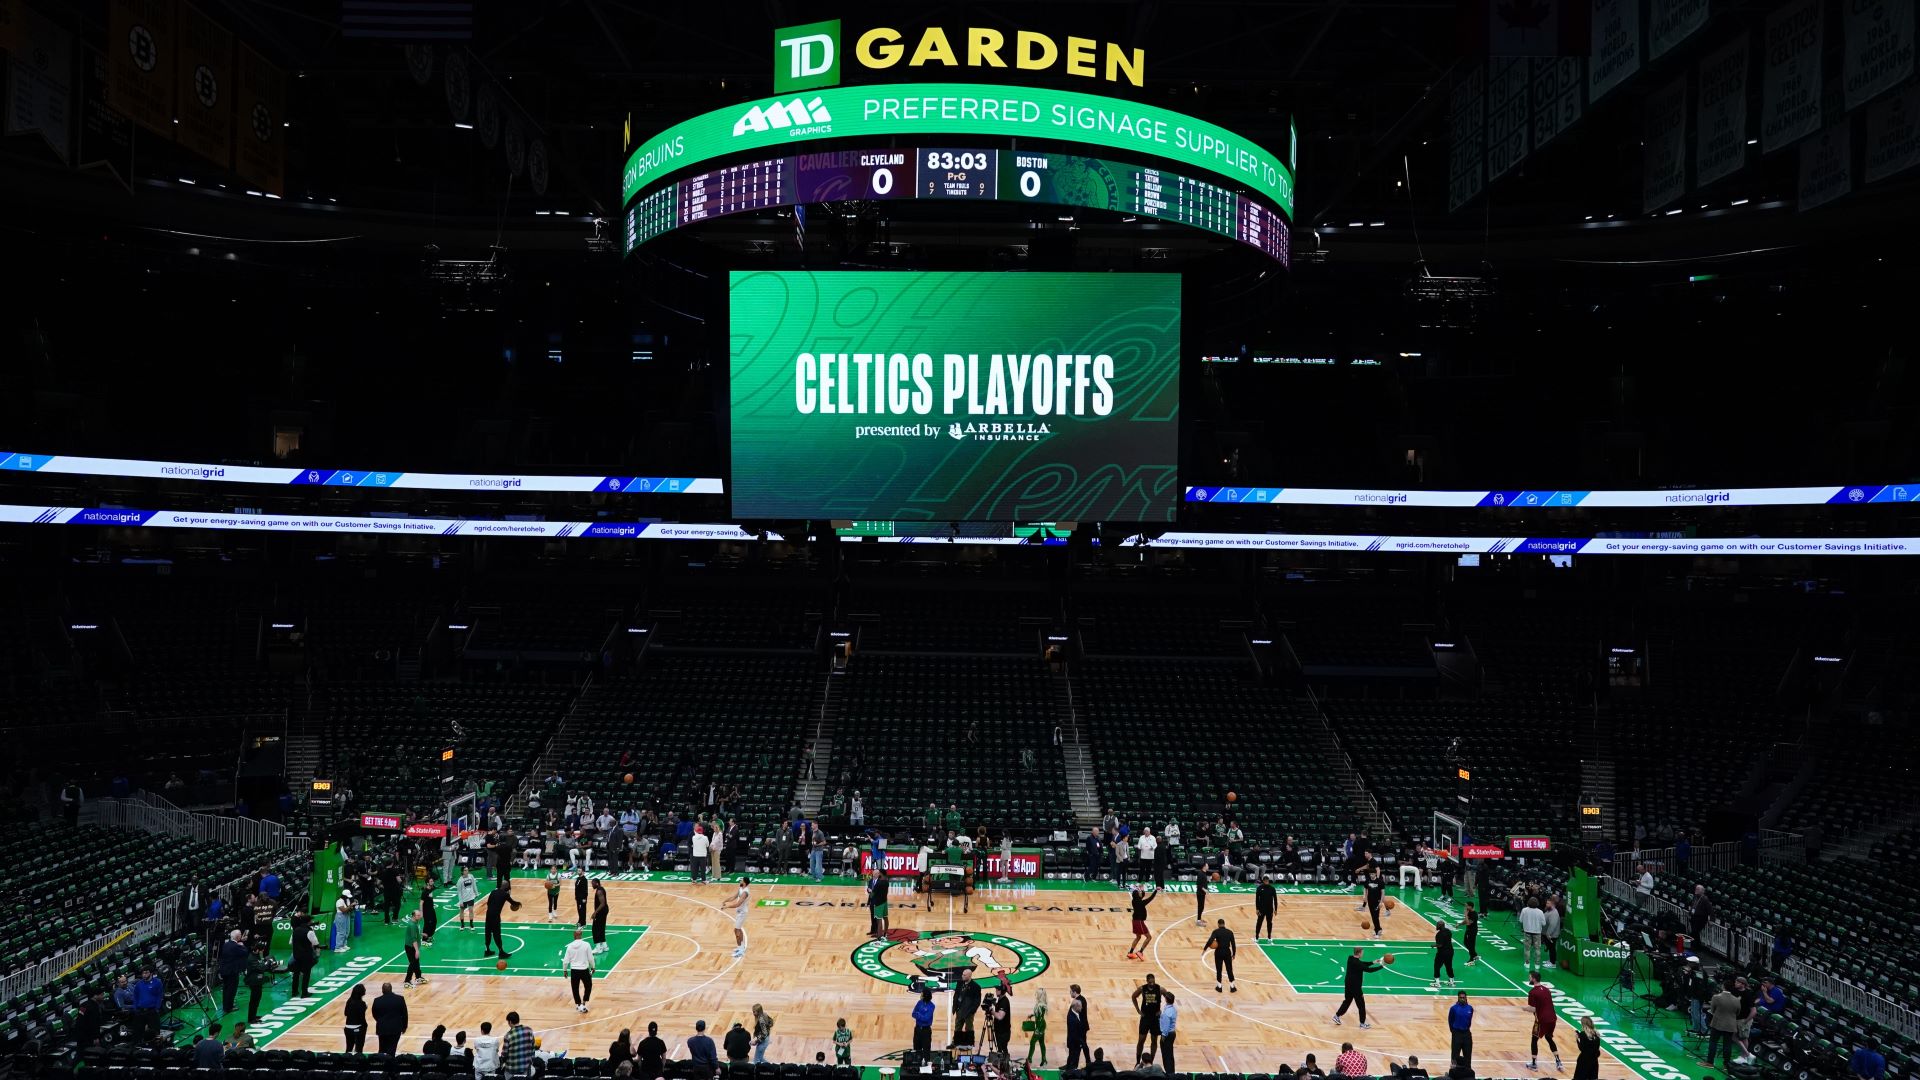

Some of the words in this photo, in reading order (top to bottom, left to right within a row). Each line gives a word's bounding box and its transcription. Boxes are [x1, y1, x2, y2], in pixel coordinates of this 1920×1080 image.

[780, 34, 834, 78] TD
[856, 27, 1146, 87] GARDEN
[790, 125, 832, 136] GRAPHICS
[864, 97, 1040, 124] PREFERRED
[1052, 104, 1167, 142] SIGNAGE
[1175, 127, 1258, 176] SUPPLIER
[1262, 162, 1276, 186] TO
[1279, 174, 1287, 198] TD
[639, 136, 684, 176] BRUINS
[861, 154, 904, 166] CLEVELAND
[928, 152, 987, 170] 83:03
[1017, 157, 1048, 169] BOSTON
[872, 168, 893, 194] 0
[948, 172, 966, 180] PrG
[1020, 171, 1041, 197] 0
[795, 352, 933, 414] CELTICS
[944, 354, 1114, 416] PLAYOFFS
[855, 424, 920, 438] presented
[924, 424, 941, 438] by
[964, 422, 1050, 433] ARBELLA
[161, 466, 224, 478] nationalgrid
[470, 478, 521, 488] nationalgrid
[1354, 493, 1407, 504] nationalgrid
[1665, 492, 1729, 503] nationalgrid
[84, 512, 140, 522] nationalgrid
[190, 518, 208, 526] your
[211, 519, 265, 527] energy-saving
[373, 522, 401, 530] Savings
[474, 525, 545, 534] ngrid.com/heretohelp
[690, 529, 738, 537] energy-saving
[1156, 538, 1203, 546] energy-saving
[1396, 542, 1470, 550] ngrid.com/heretohelp
[1528, 542, 1576, 550] nationalgrid
[1642, 543, 1698, 552] energy-saving
[1700, 544, 1724, 552] game
[1825, 543, 1861, 552] Savings
[1864, 543, 1906, 551] Initiative.
[1021, 859, 1036, 875] App
[991, 937, 1044, 973] CELTICS
[245, 997, 322, 1044] OSTON
[307, 956, 382, 994] CELTICS
